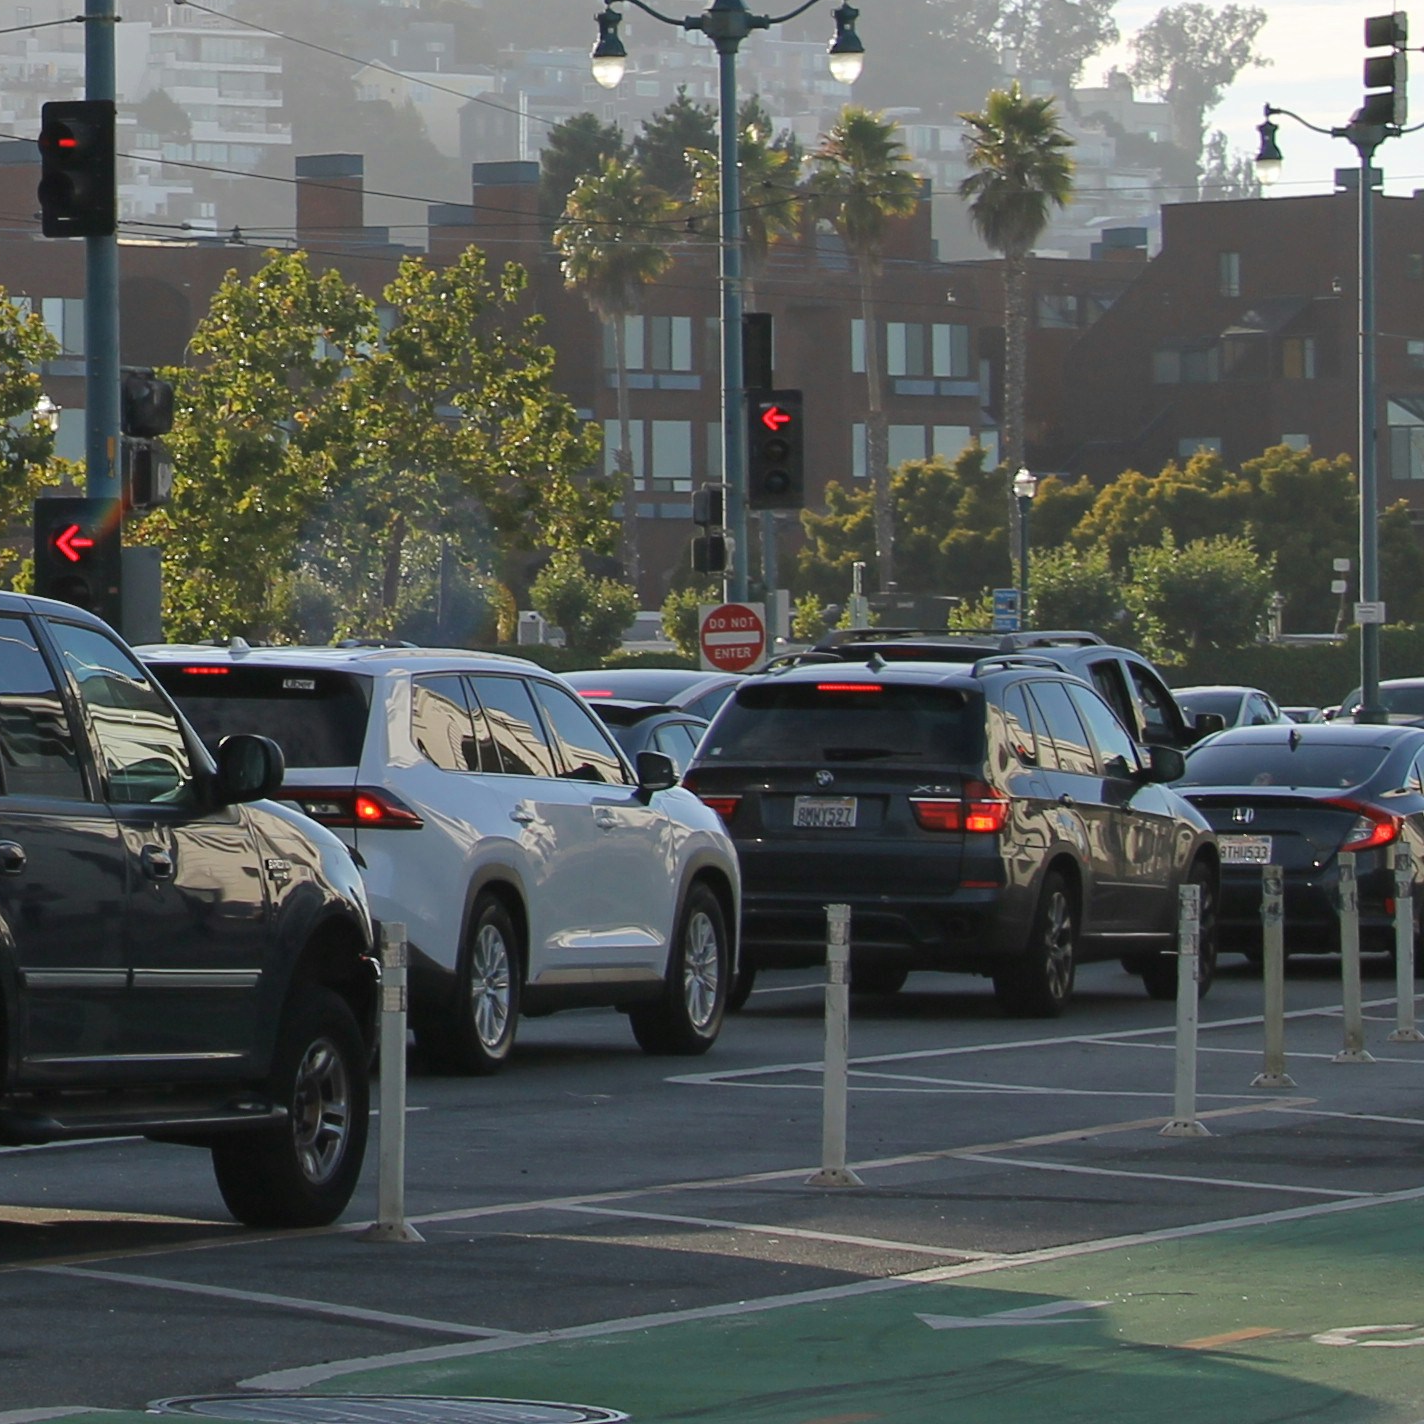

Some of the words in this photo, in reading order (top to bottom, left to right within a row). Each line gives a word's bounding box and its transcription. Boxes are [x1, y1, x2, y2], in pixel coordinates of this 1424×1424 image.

[709, 618, 726, 629] DO
[731, 617, 754, 628] NOT
[714, 647, 752, 659] ENTER
